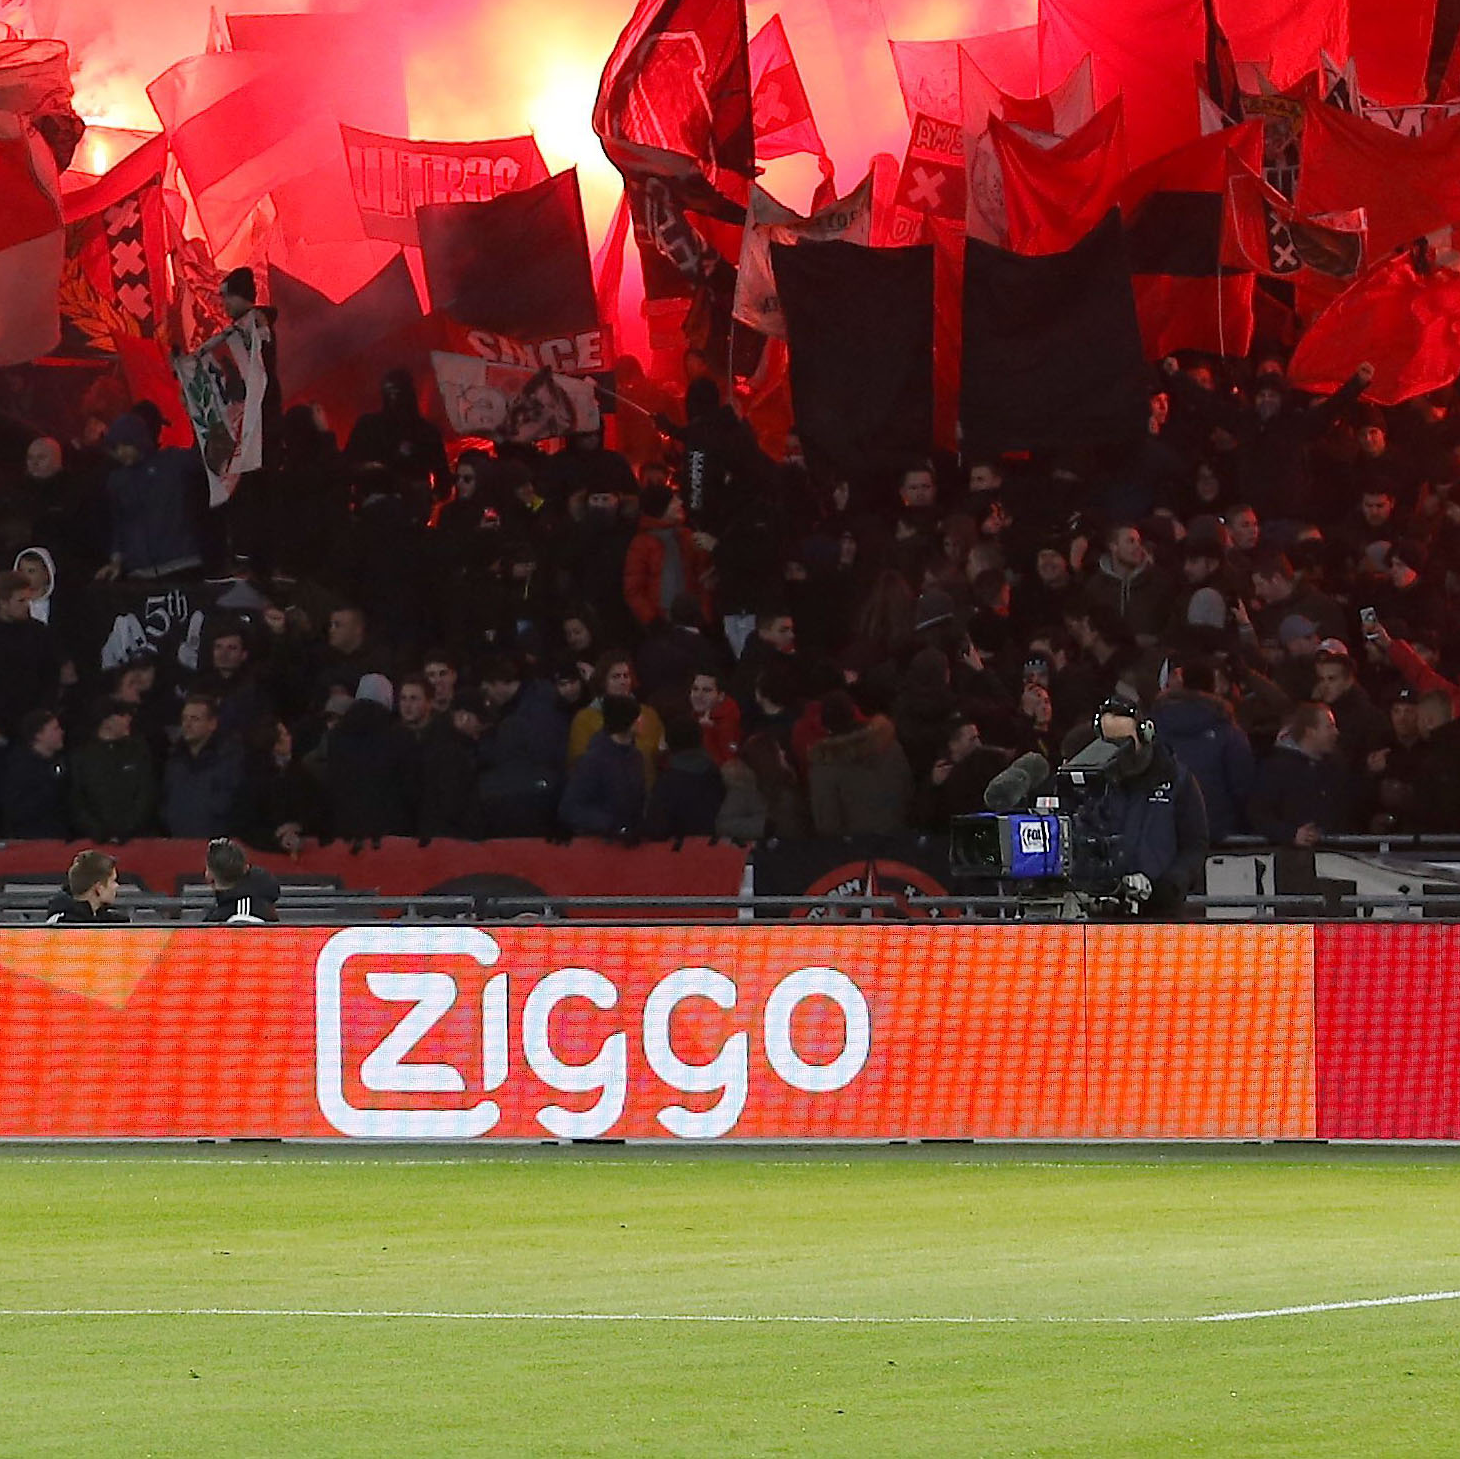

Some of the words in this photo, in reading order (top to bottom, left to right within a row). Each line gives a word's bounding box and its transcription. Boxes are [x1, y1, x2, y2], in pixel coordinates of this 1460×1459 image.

[348, 146, 522, 220] ULTRAS
[467, 330, 603, 374] SINCE
[145, 589, 189, 637] 5th
